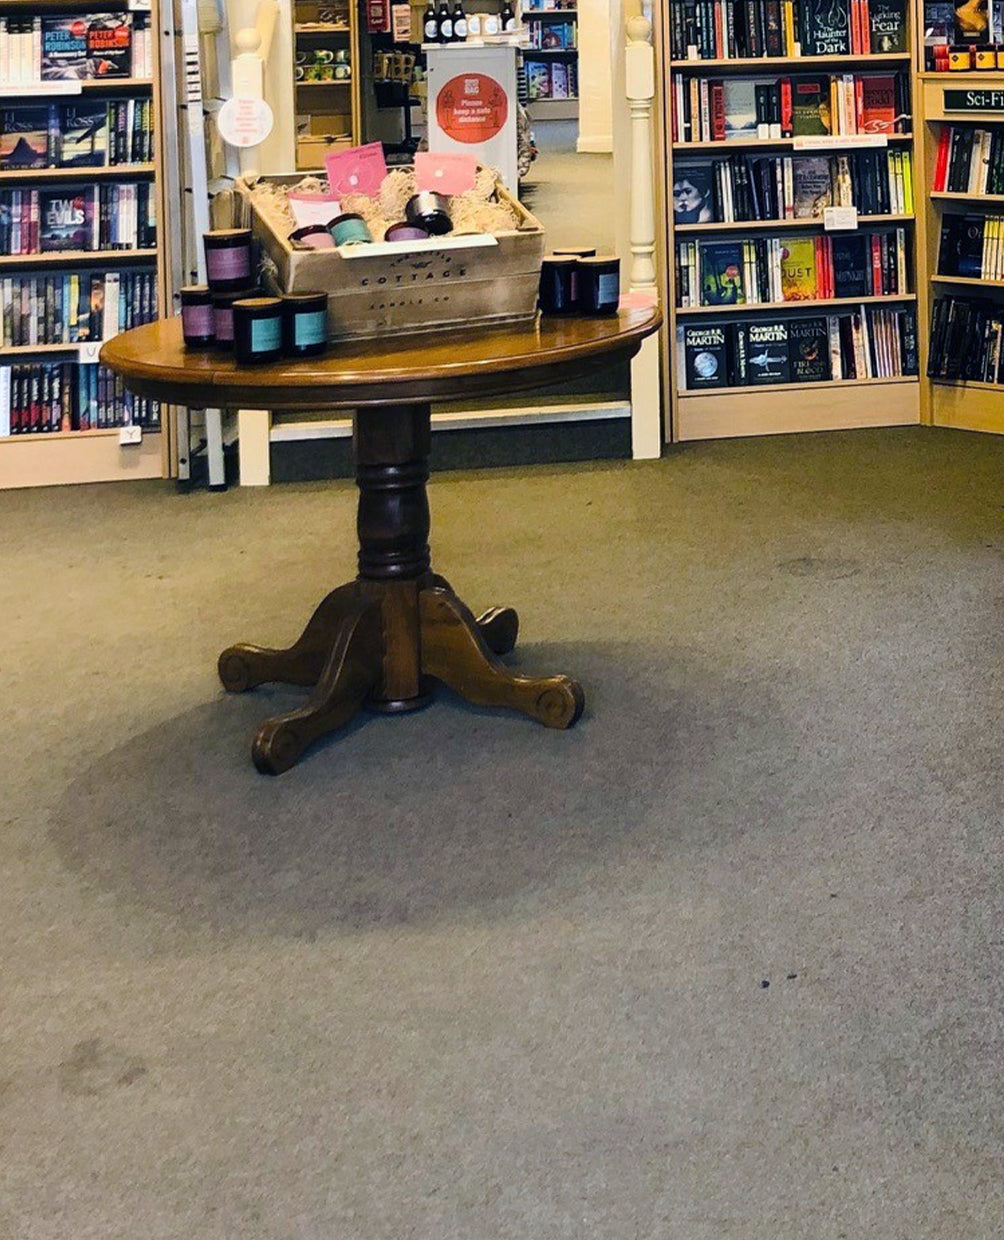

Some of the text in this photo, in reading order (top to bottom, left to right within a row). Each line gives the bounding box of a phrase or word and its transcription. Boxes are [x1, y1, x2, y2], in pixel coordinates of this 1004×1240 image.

[872, 20, 900, 32] Fear
[45, 31, 71, 41] PETER
[813, 30, 847, 39] Haunter
[45, 41, 86, 51] ROBINSON
[816, 40, 846, 54] Dark
[966, 91, 1004, 106] Sci-Fi
[4, 122, 33, 132] ROSS
[67, 117, 95, 128] ROSS
[47, 210, 86, 225] EVILS
[361, 267, 467, 286] COTTAGE
[749, 331, 788, 343] MARTIN
[790, 327, 827, 339] MARTIN
[686, 334, 725, 346] MARTIN
